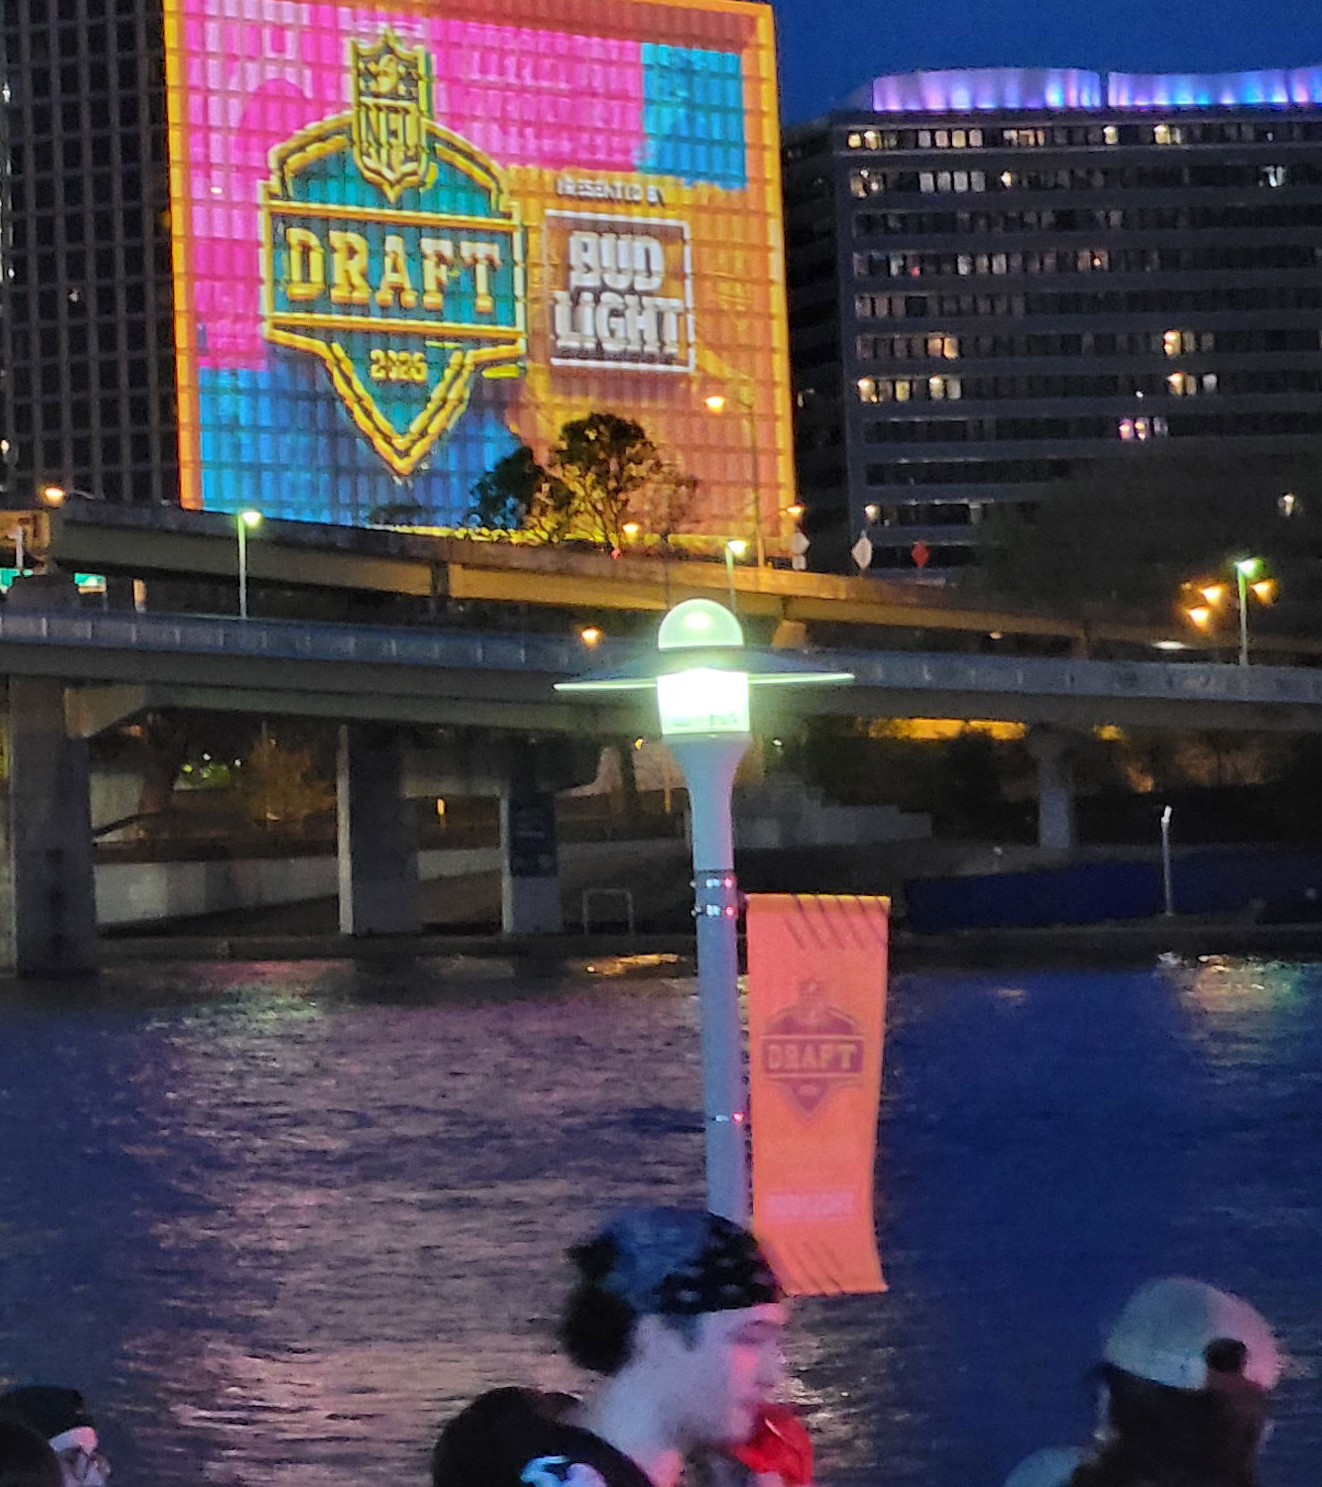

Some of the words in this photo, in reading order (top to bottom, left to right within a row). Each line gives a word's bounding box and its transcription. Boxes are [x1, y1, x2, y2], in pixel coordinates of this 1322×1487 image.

[285, 227, 502, 313] DRAFT
[569, 231, 664, 291] BUD
[550, 290, 685, 355] LIGHT
[767, 1043, 858, 1070] DRAFT
